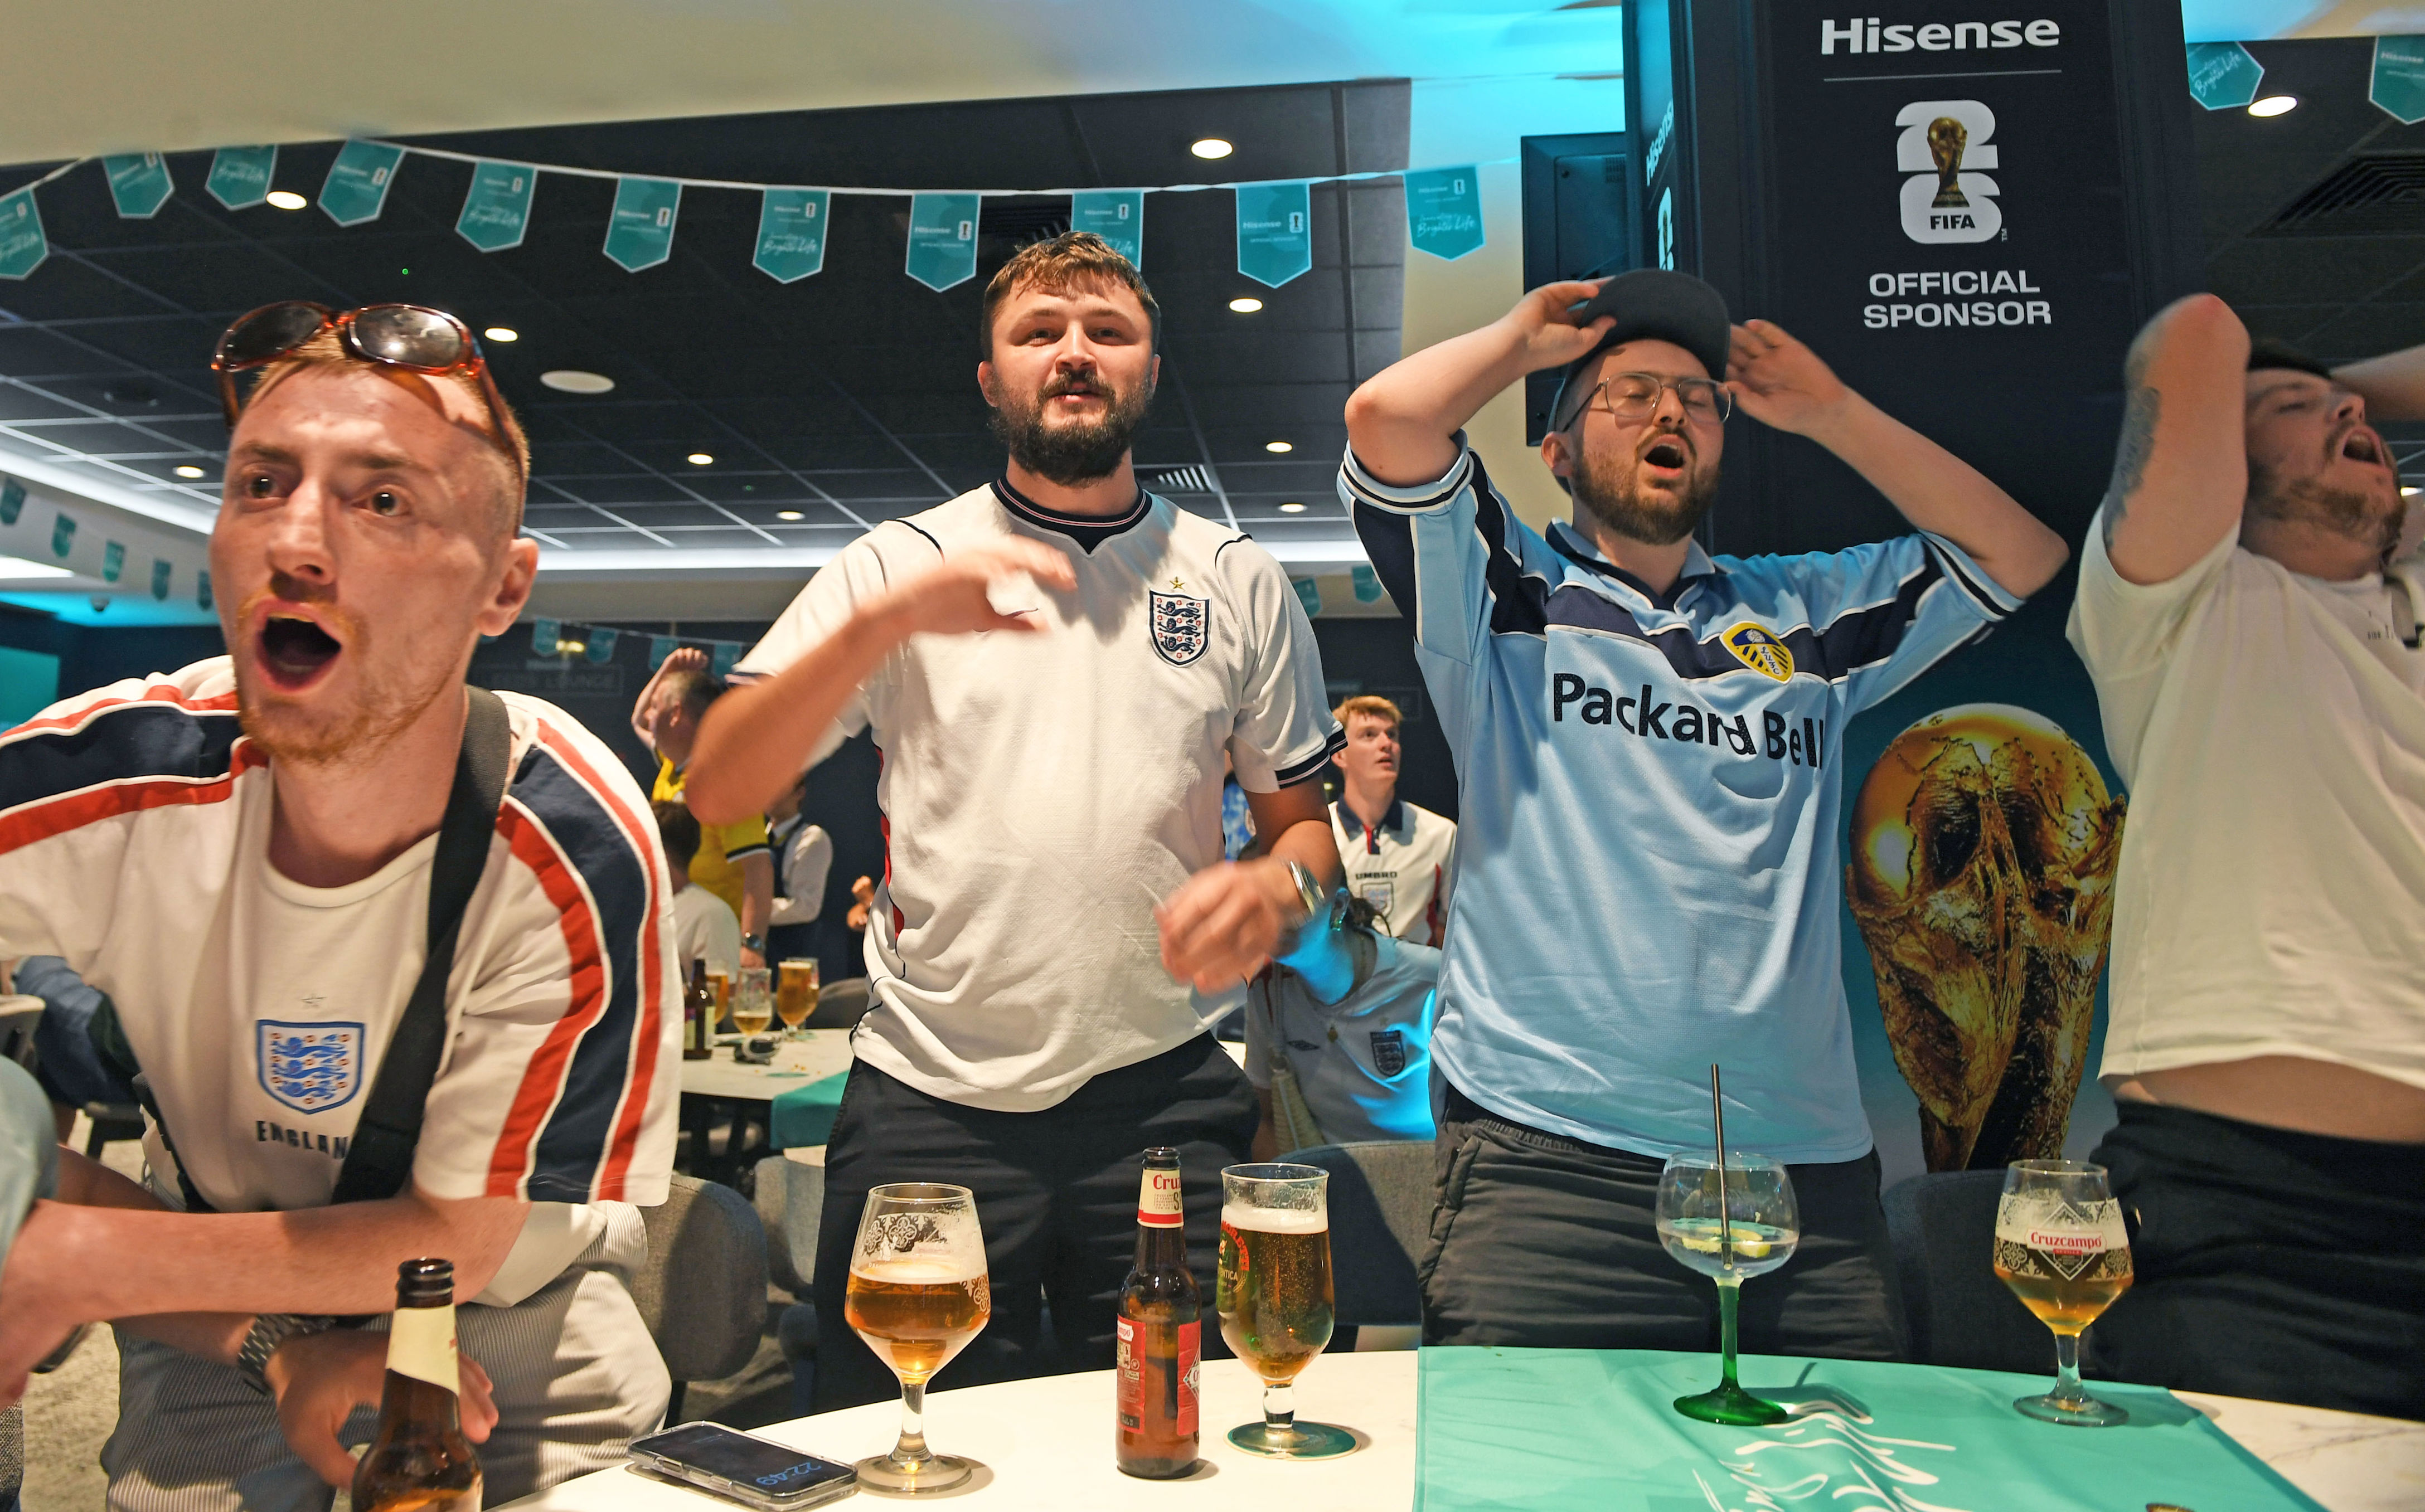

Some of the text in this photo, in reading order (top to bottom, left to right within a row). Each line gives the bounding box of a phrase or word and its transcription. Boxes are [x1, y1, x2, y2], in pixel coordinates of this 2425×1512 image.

[1821, 17, 2060, 55] Hisense
[1929, 214, 1976, 230] FIFA
[1869, 270, 2040, 296] OFFICIAL
[1864, 301, 2052, 328] SPONSOR
[1554, 673, 1823, 770] Packard Bell
[1355, 871, 1398, 880] UMBRO
